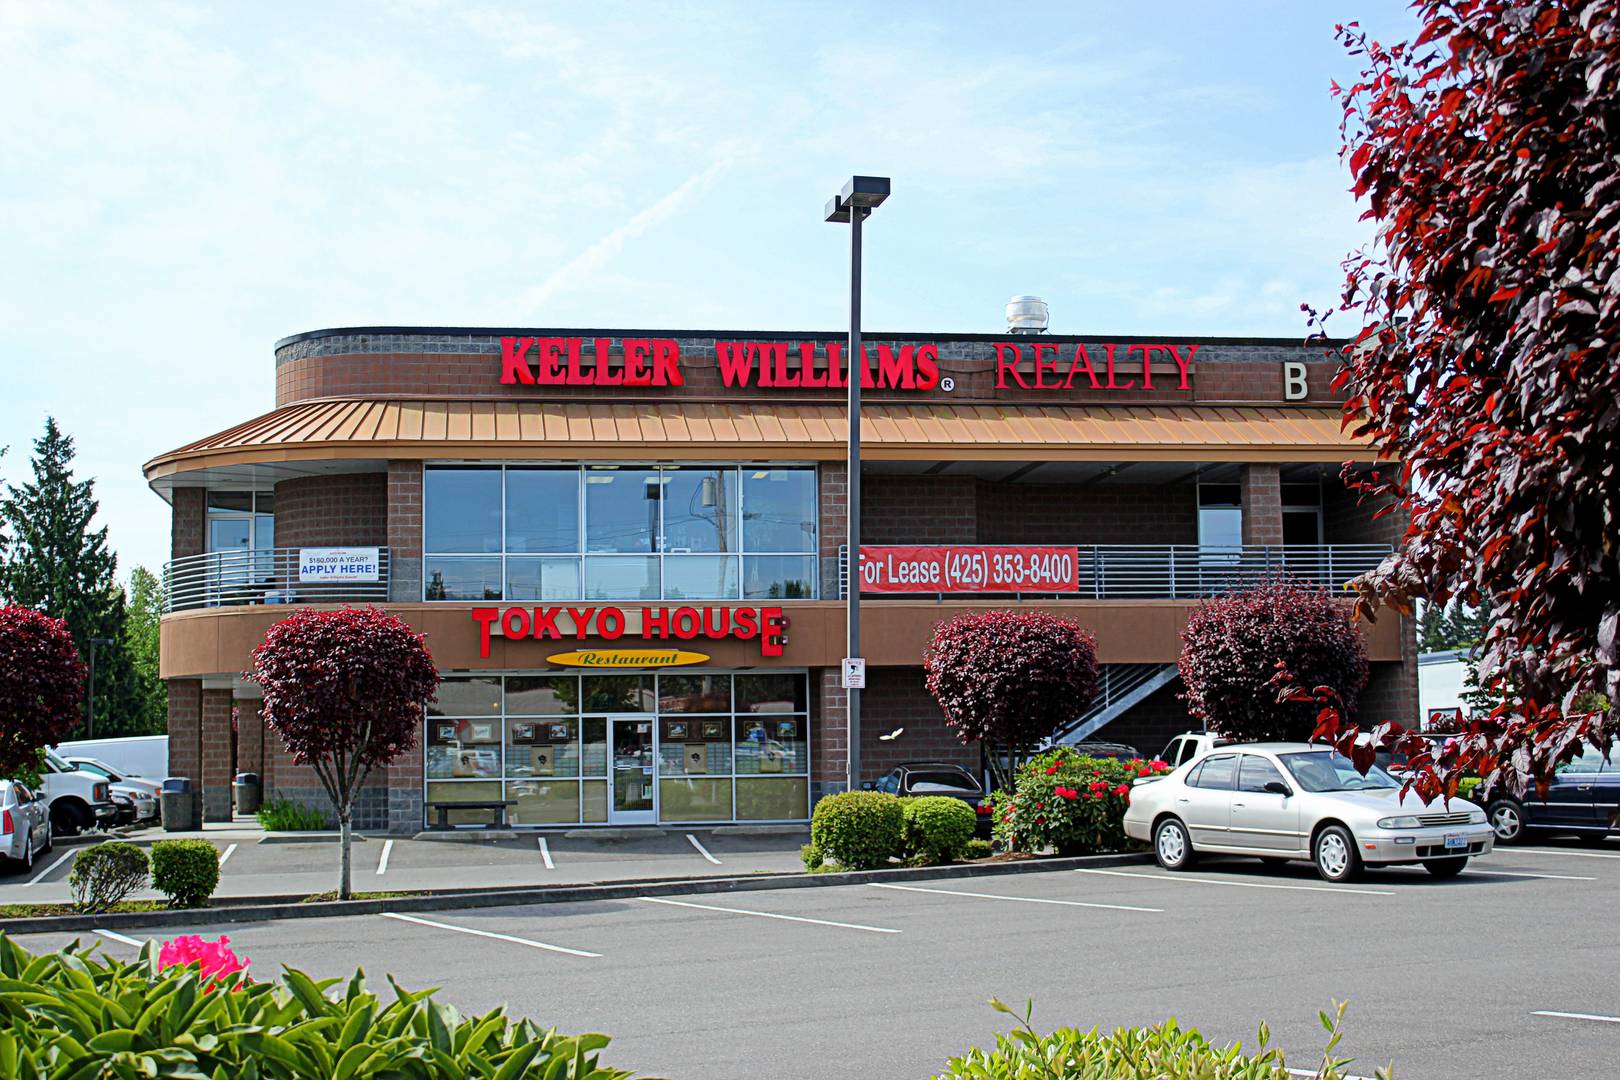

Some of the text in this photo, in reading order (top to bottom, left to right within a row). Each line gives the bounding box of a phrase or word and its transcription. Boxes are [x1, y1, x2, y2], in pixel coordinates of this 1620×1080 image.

[500, 337, 684, 386] KELLER
[714, 341, 938, 390] WILLIAMS
[993, 342, 1200, 390] REALTY
[1284, 362, 1308, 400] B
[302, 564, 376, 574] APPLY HERE!
[888, 554, 940, 583] Lease
[945, 551, 988, 587] (425)
[993, 554, 1072, 583] 353-8400
[472, 607, 783, 658] TOKYO HOUSE
[578, 653, 678, 665] Restaurant
